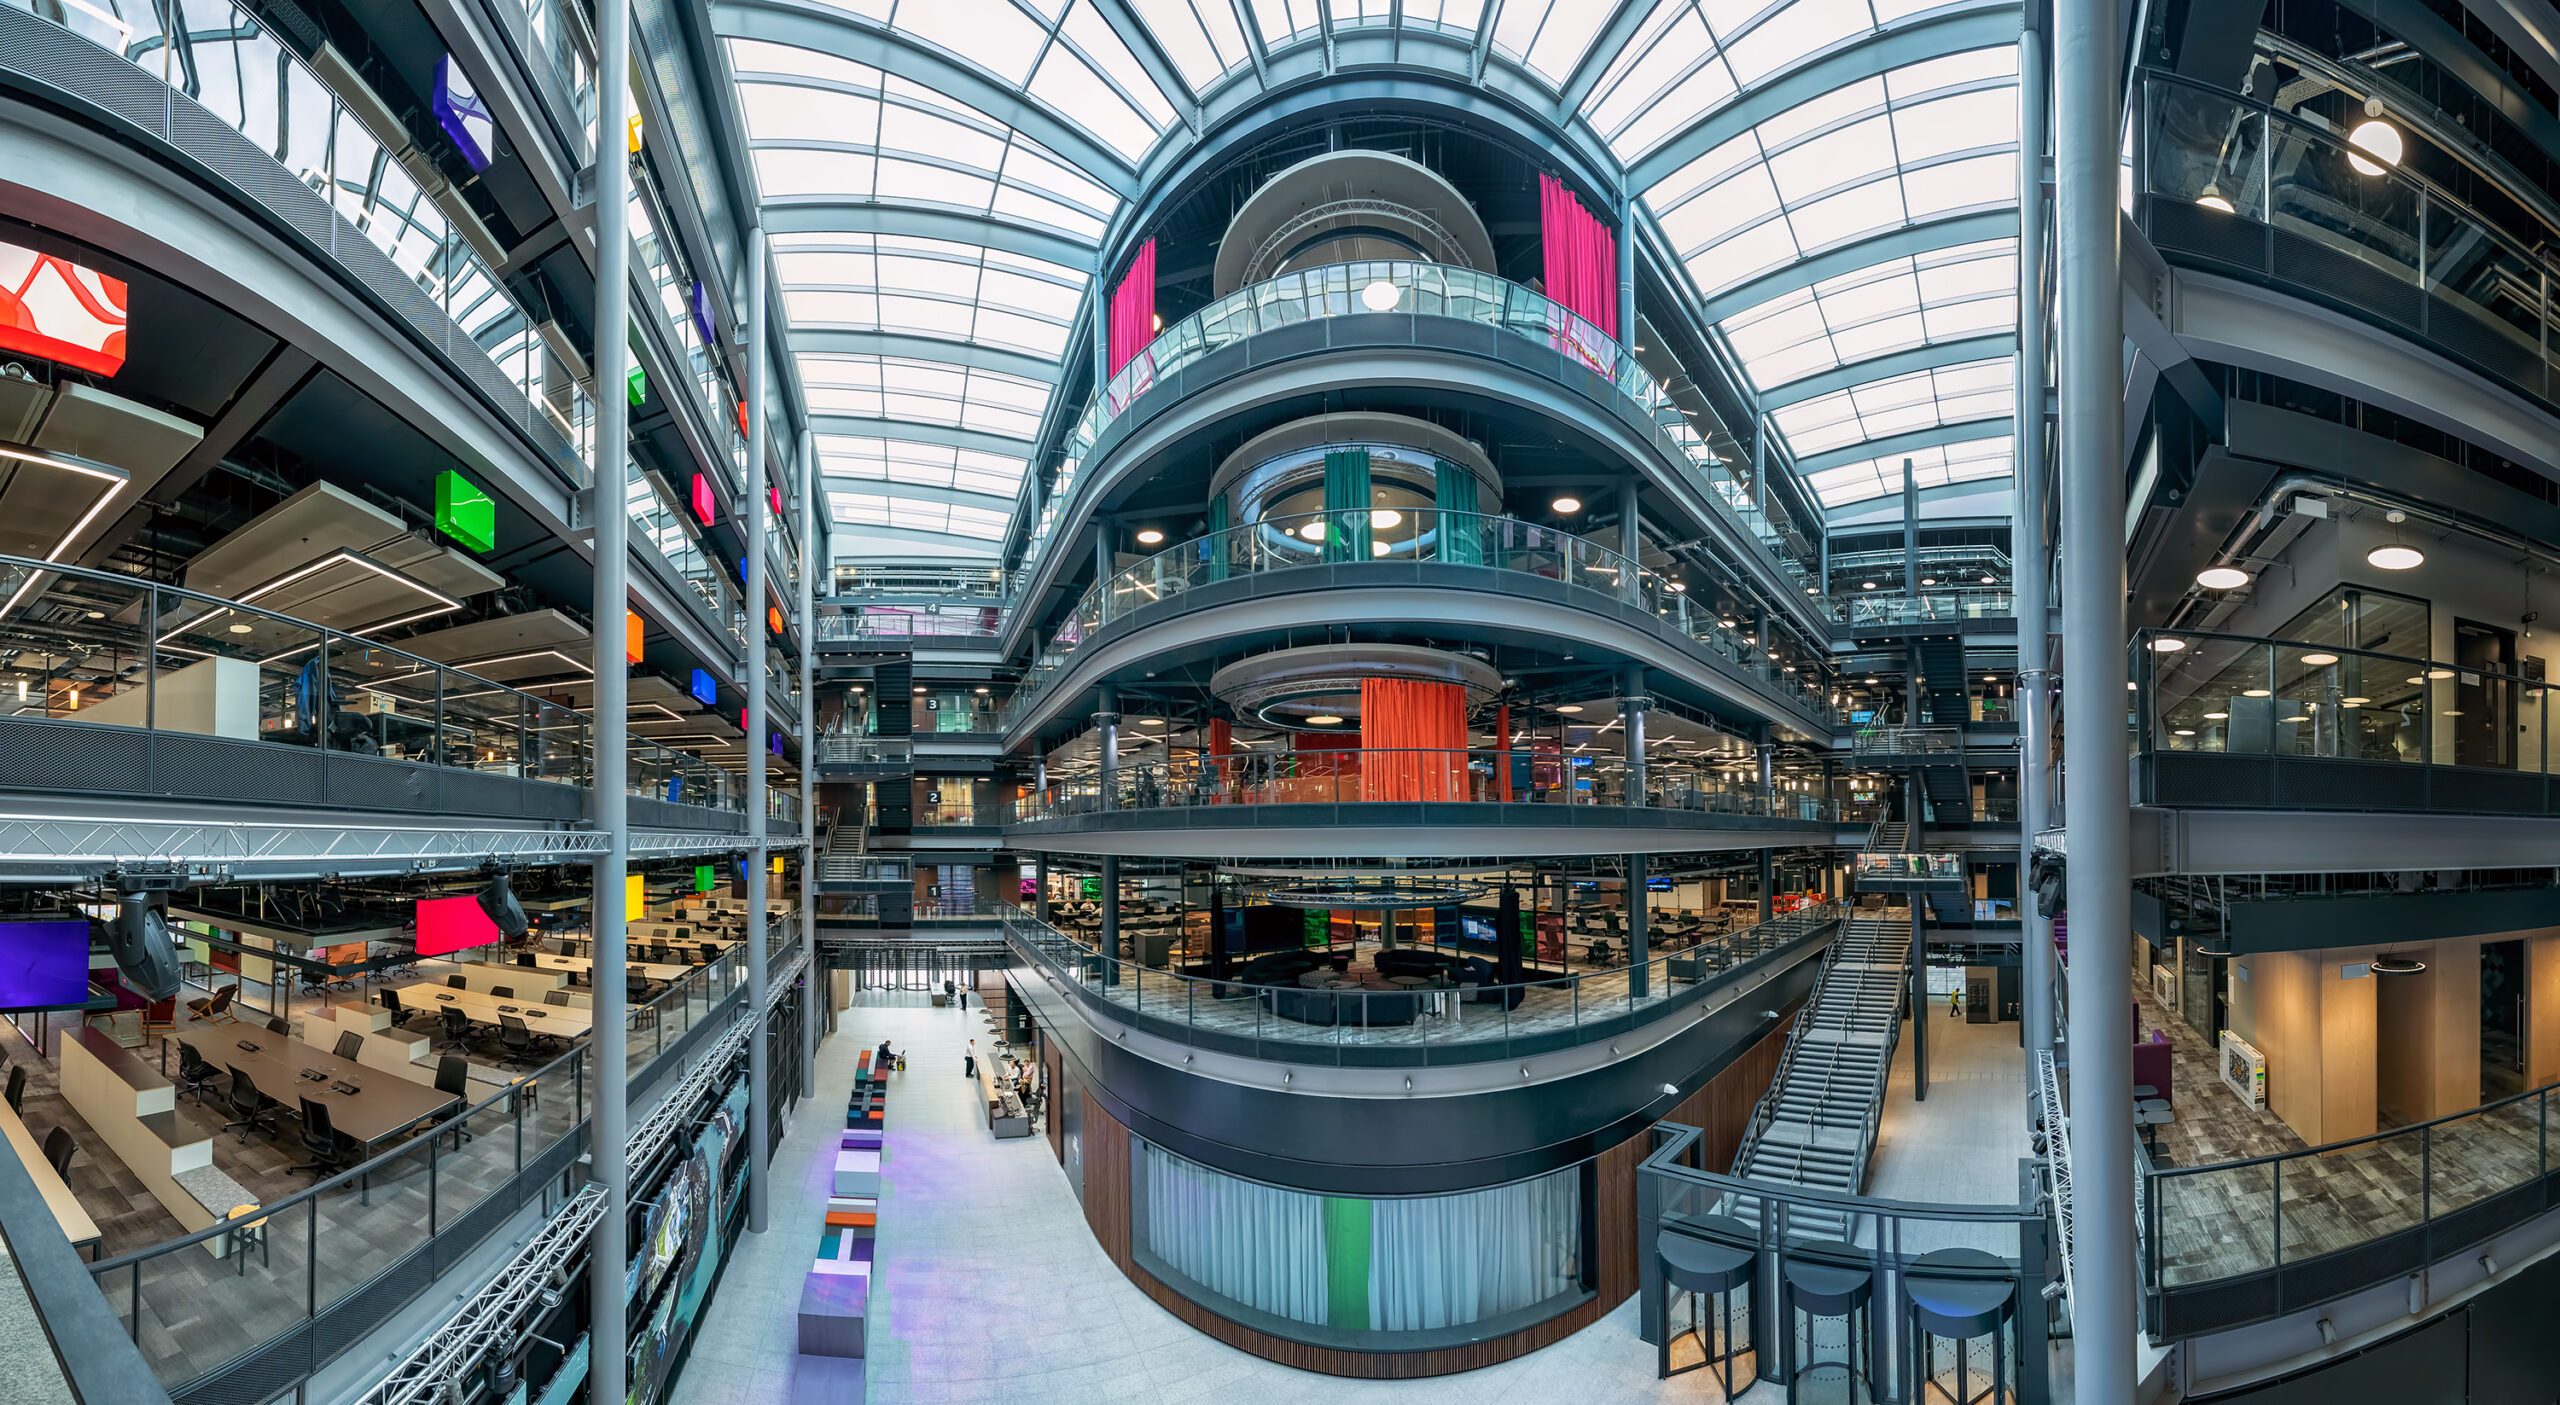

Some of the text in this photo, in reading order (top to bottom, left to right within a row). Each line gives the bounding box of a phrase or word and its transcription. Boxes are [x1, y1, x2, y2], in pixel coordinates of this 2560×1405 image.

[928, 603, 937, 613] 4
[929, 699, 937, 709] 3
[930, 793, 938, 803] 2
[930, 887, 937, 896] 1
